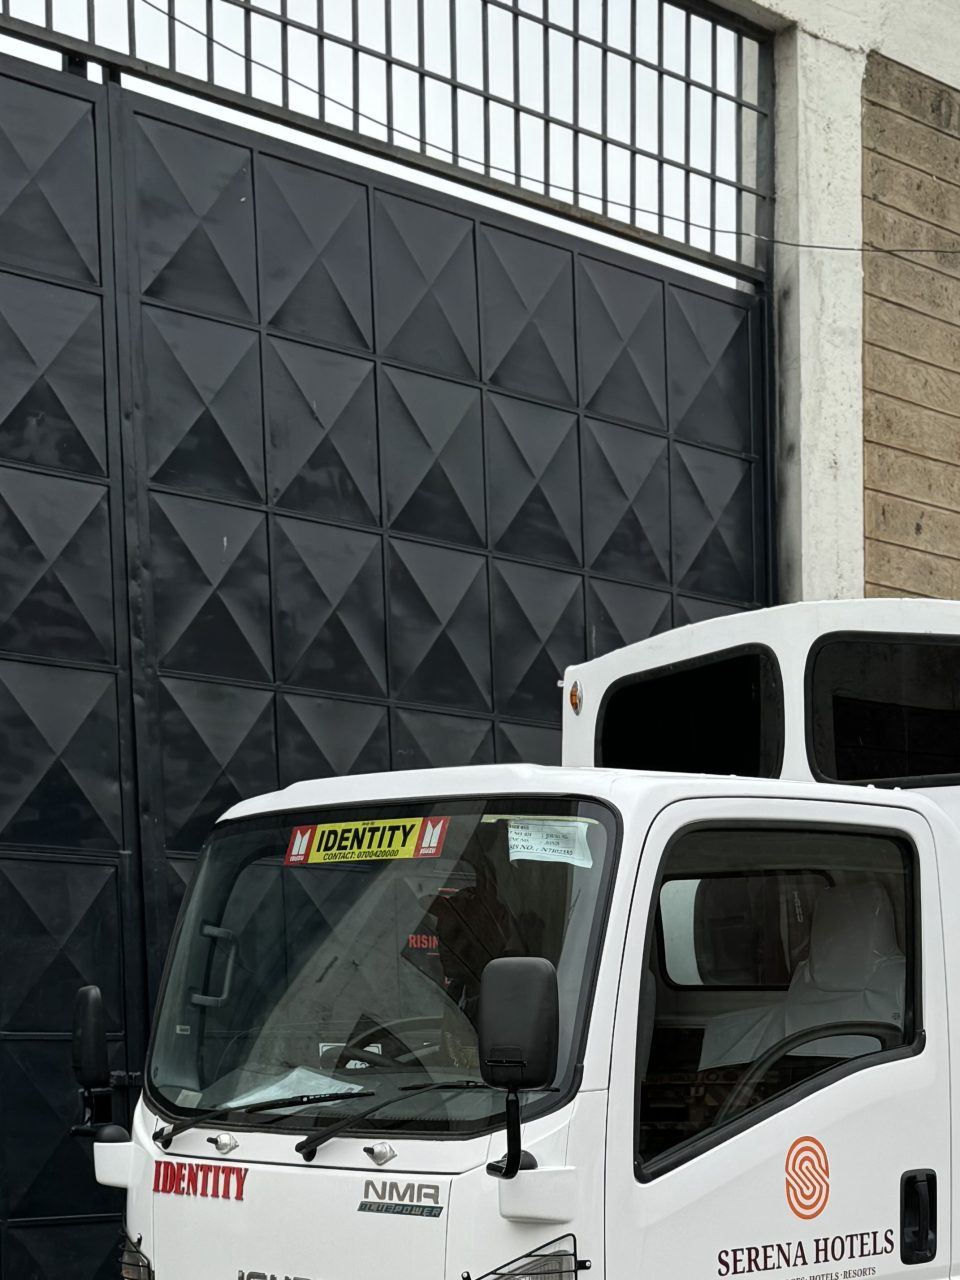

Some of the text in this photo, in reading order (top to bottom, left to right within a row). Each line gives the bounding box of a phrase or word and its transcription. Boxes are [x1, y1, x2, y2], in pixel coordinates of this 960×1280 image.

[315, 824, 416, 853] IDENTITY
[152, 1159, 249, 1201] IDENTITY
[363, 1179, 440, 1205] NMR
[717, 1229, 895, 1277] SERENA HOTELS
[843, 1266, 877, 1280] RESORTS
